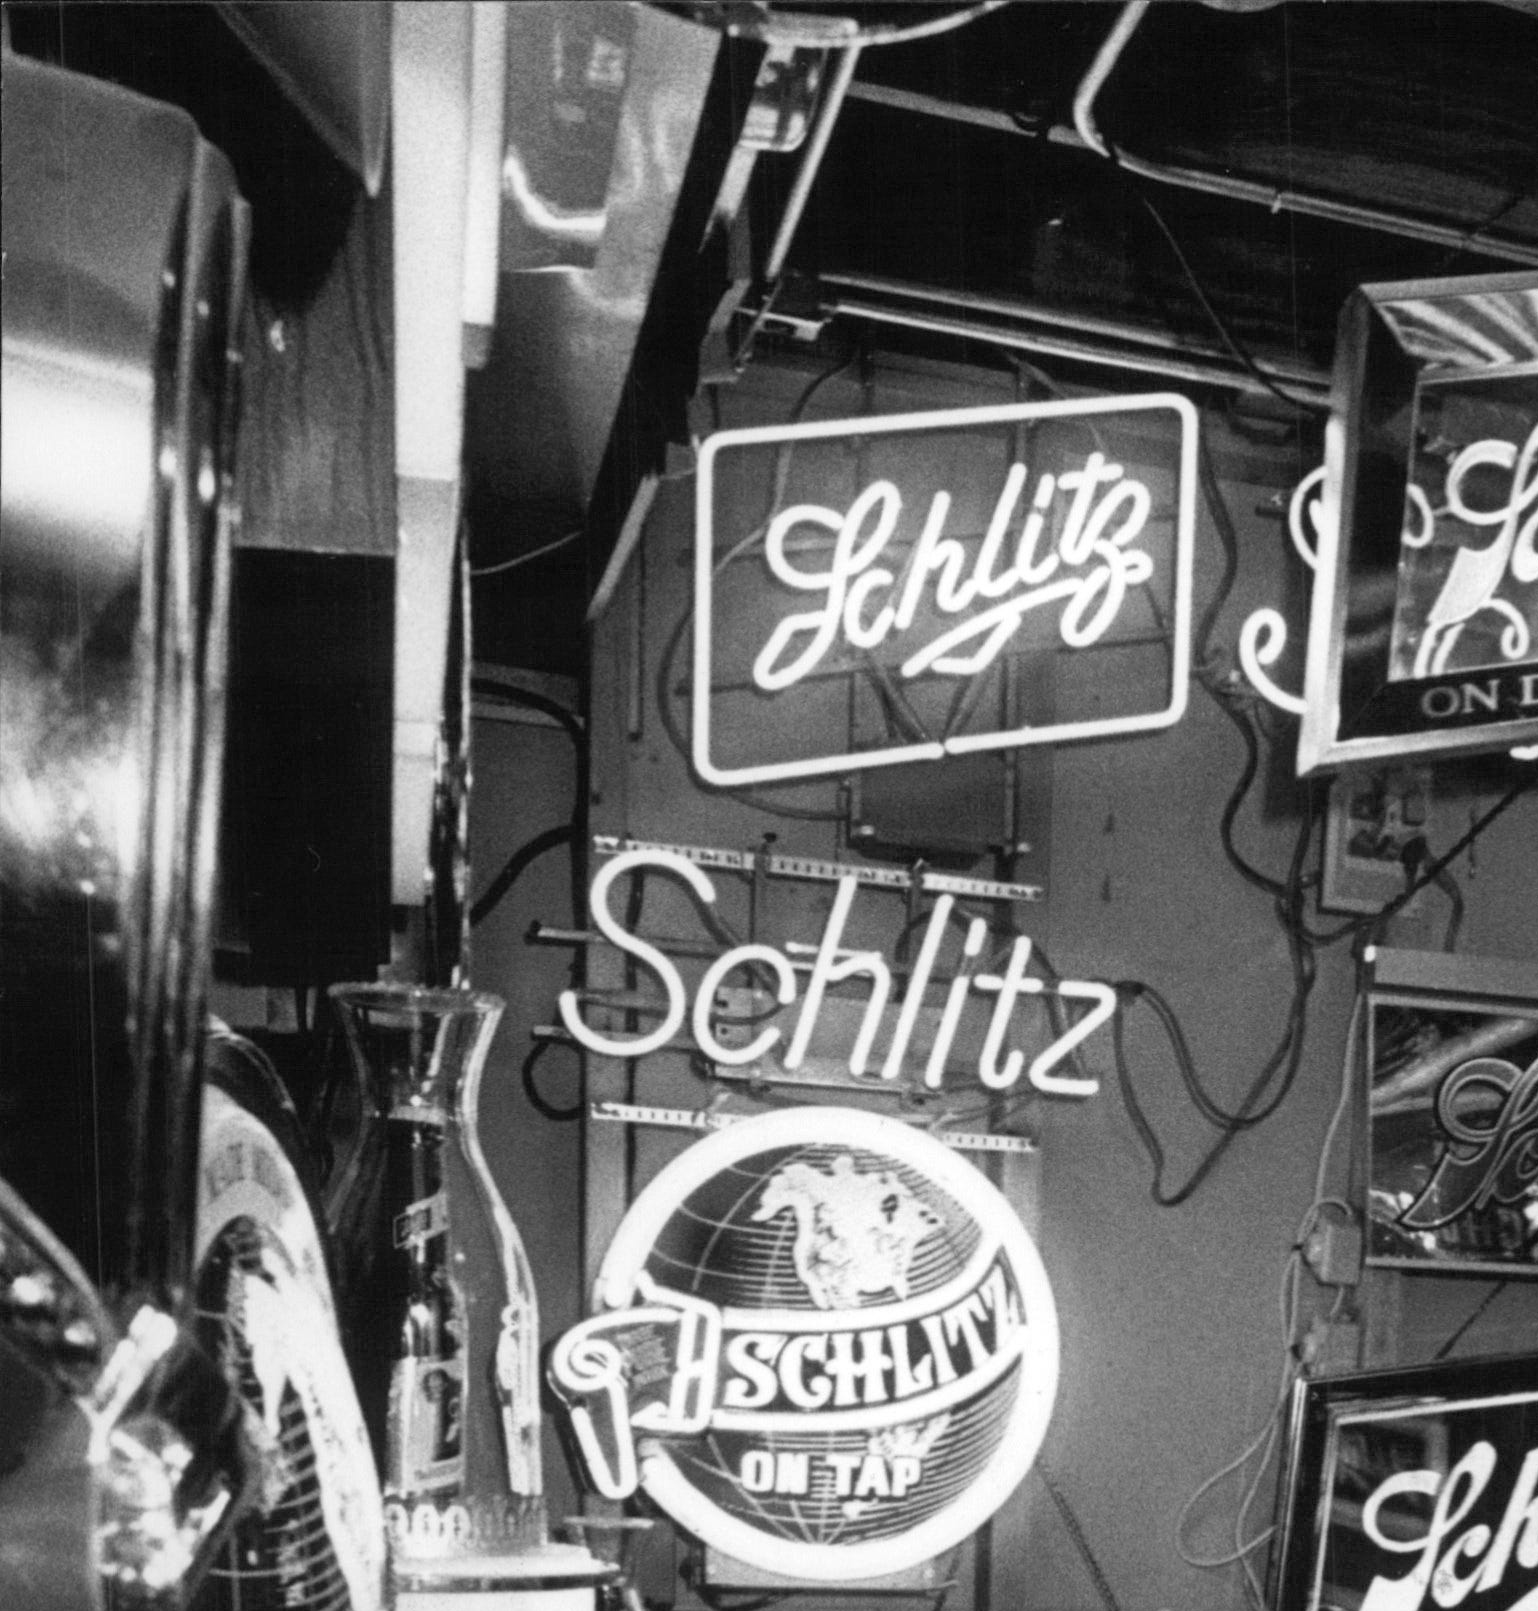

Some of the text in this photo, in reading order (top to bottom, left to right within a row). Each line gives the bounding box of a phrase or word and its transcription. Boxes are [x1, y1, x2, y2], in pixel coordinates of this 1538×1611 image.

[752, 451, 1154, 692] Schlitz
[1421, 678, 1500, 718] ON
[559, 847, 1117, 1096] Schlitz
[740, 1449, 922, 1498] ON TAP
